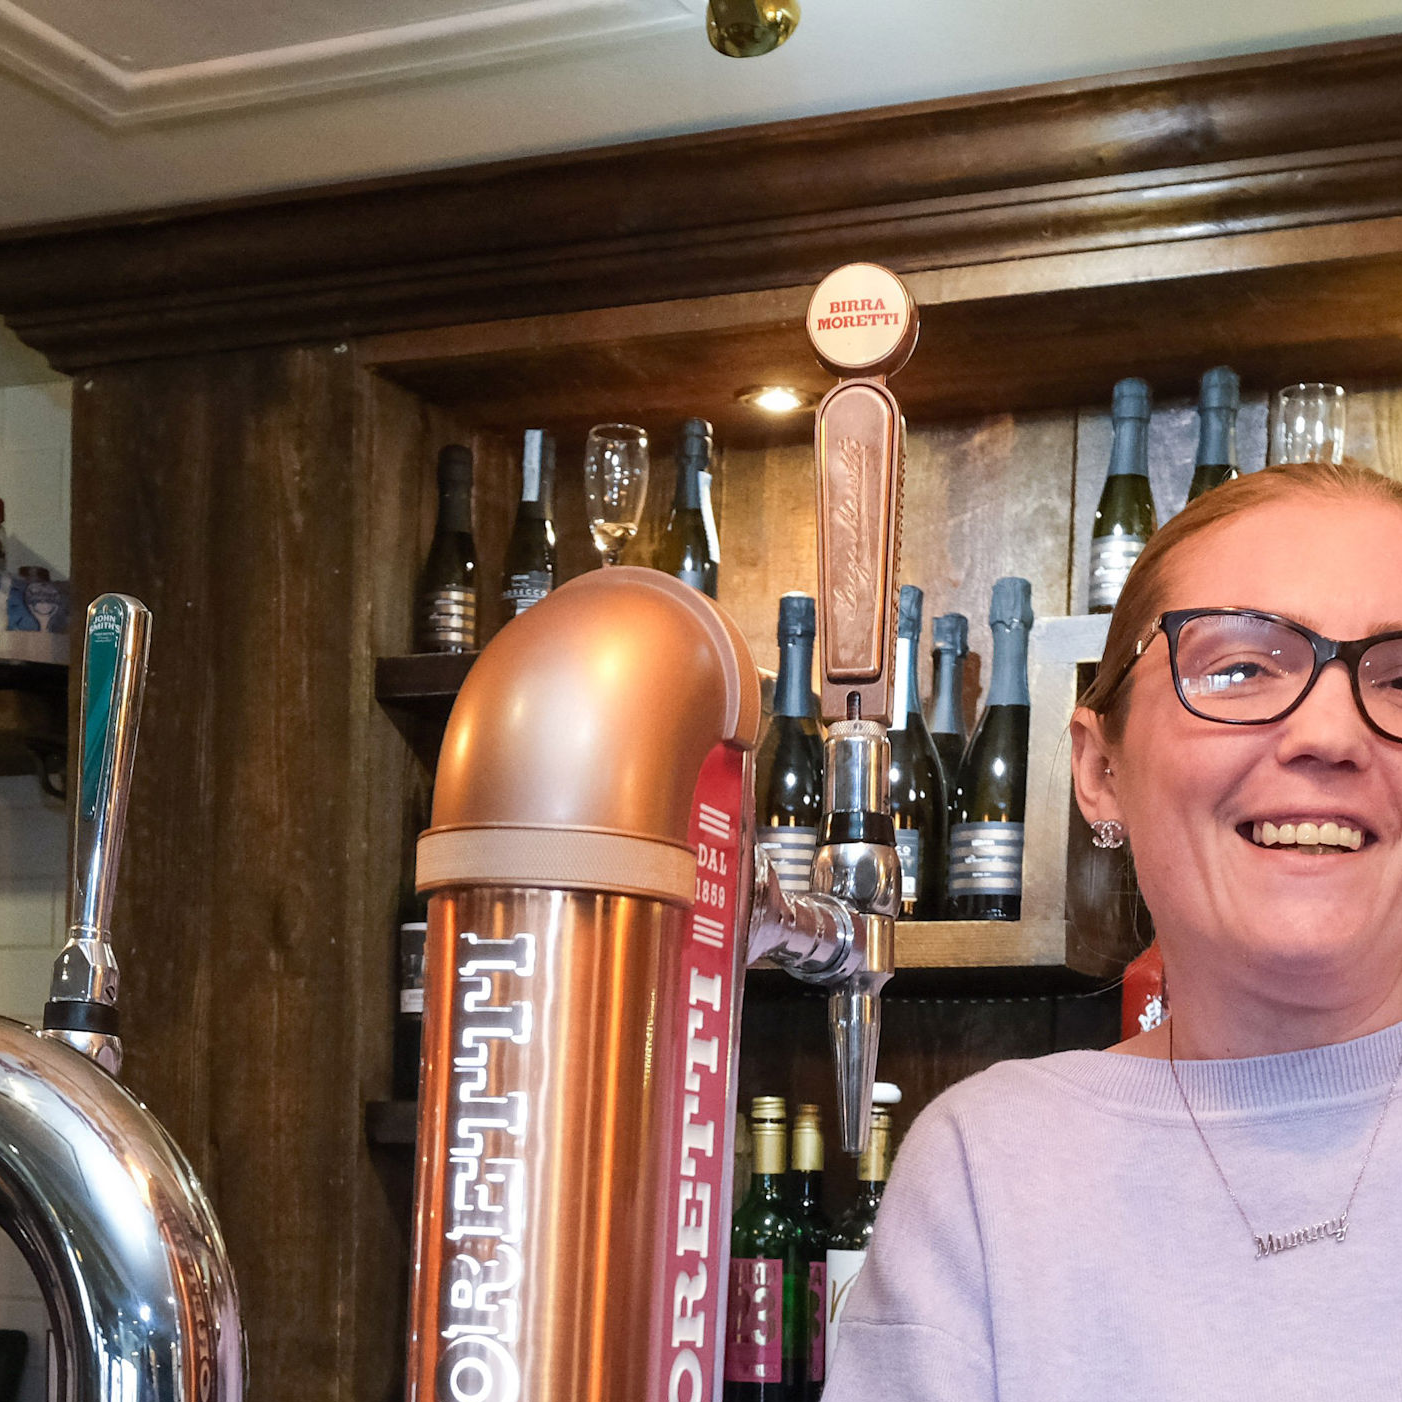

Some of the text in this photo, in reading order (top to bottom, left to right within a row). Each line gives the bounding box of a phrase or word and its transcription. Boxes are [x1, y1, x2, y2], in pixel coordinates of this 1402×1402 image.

[829, 298, 886, 314] BIRRA
[817, 313, 900, 331] MORETTI
[93, 614, 116, 624] JOHN
[89, 621, 122, 635] SMITH'S
[697, 842, 728, 876] DAL
